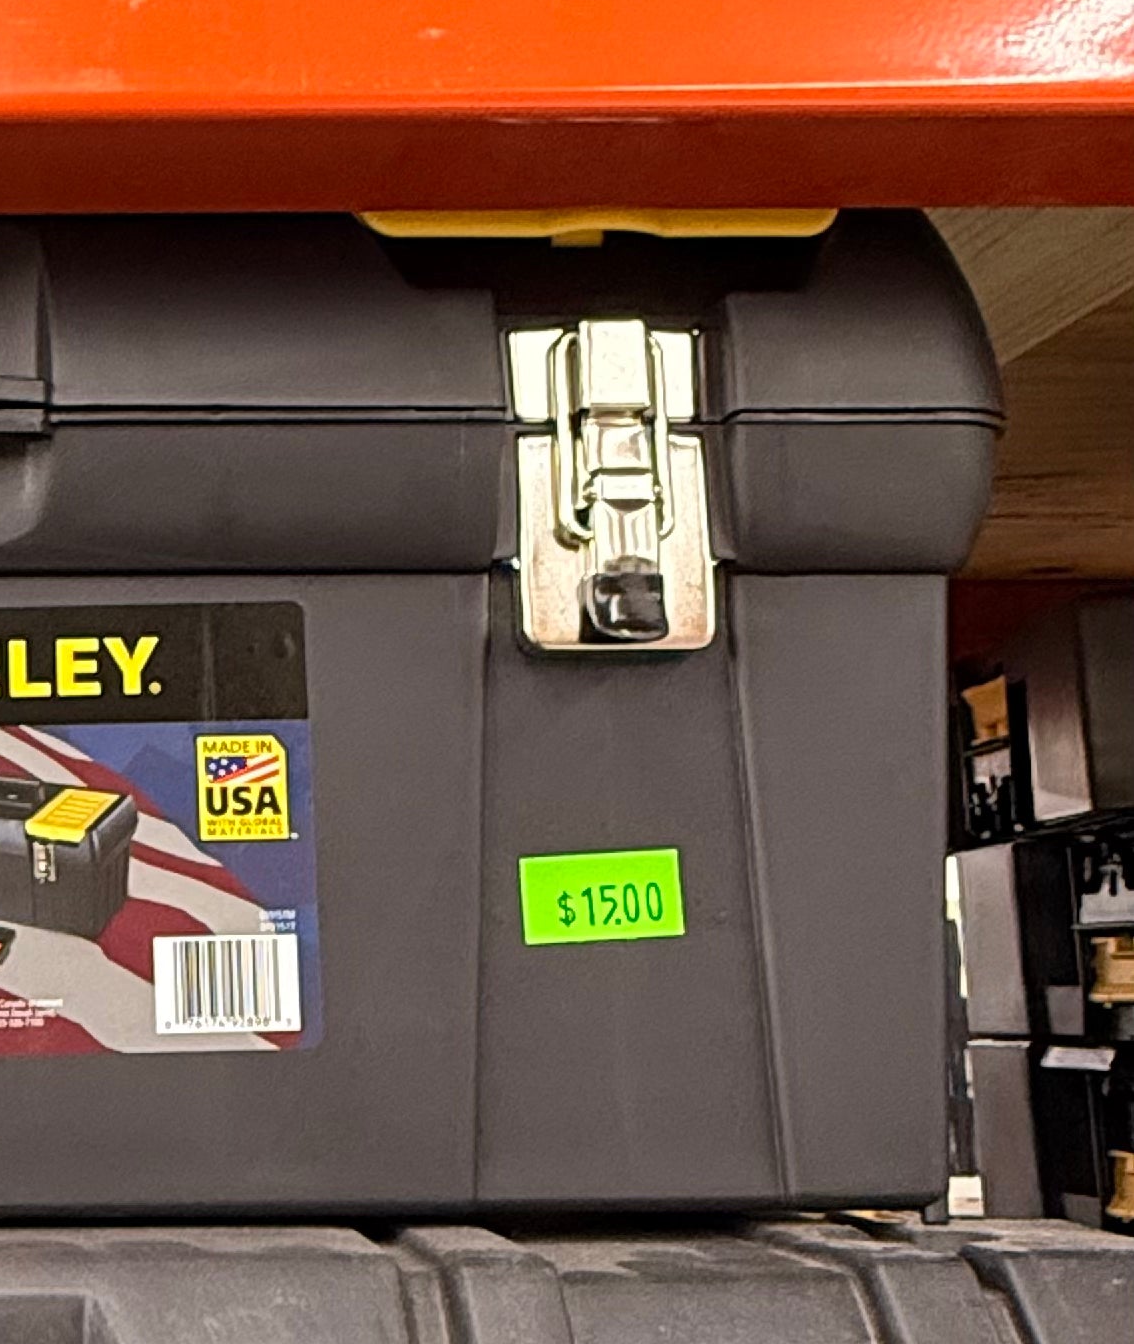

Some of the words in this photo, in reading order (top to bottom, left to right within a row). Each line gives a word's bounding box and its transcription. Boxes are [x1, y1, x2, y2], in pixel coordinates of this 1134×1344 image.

[203, 741, 250, 753] MADE
[256, 740, 272, 753] IN
[206, 786, 282, 816] USA
[239, 817, 282, 826] GLOBAL
[207, 827, 284, 836] MATERIALS
[557, 882, 663, 927] $15.00
